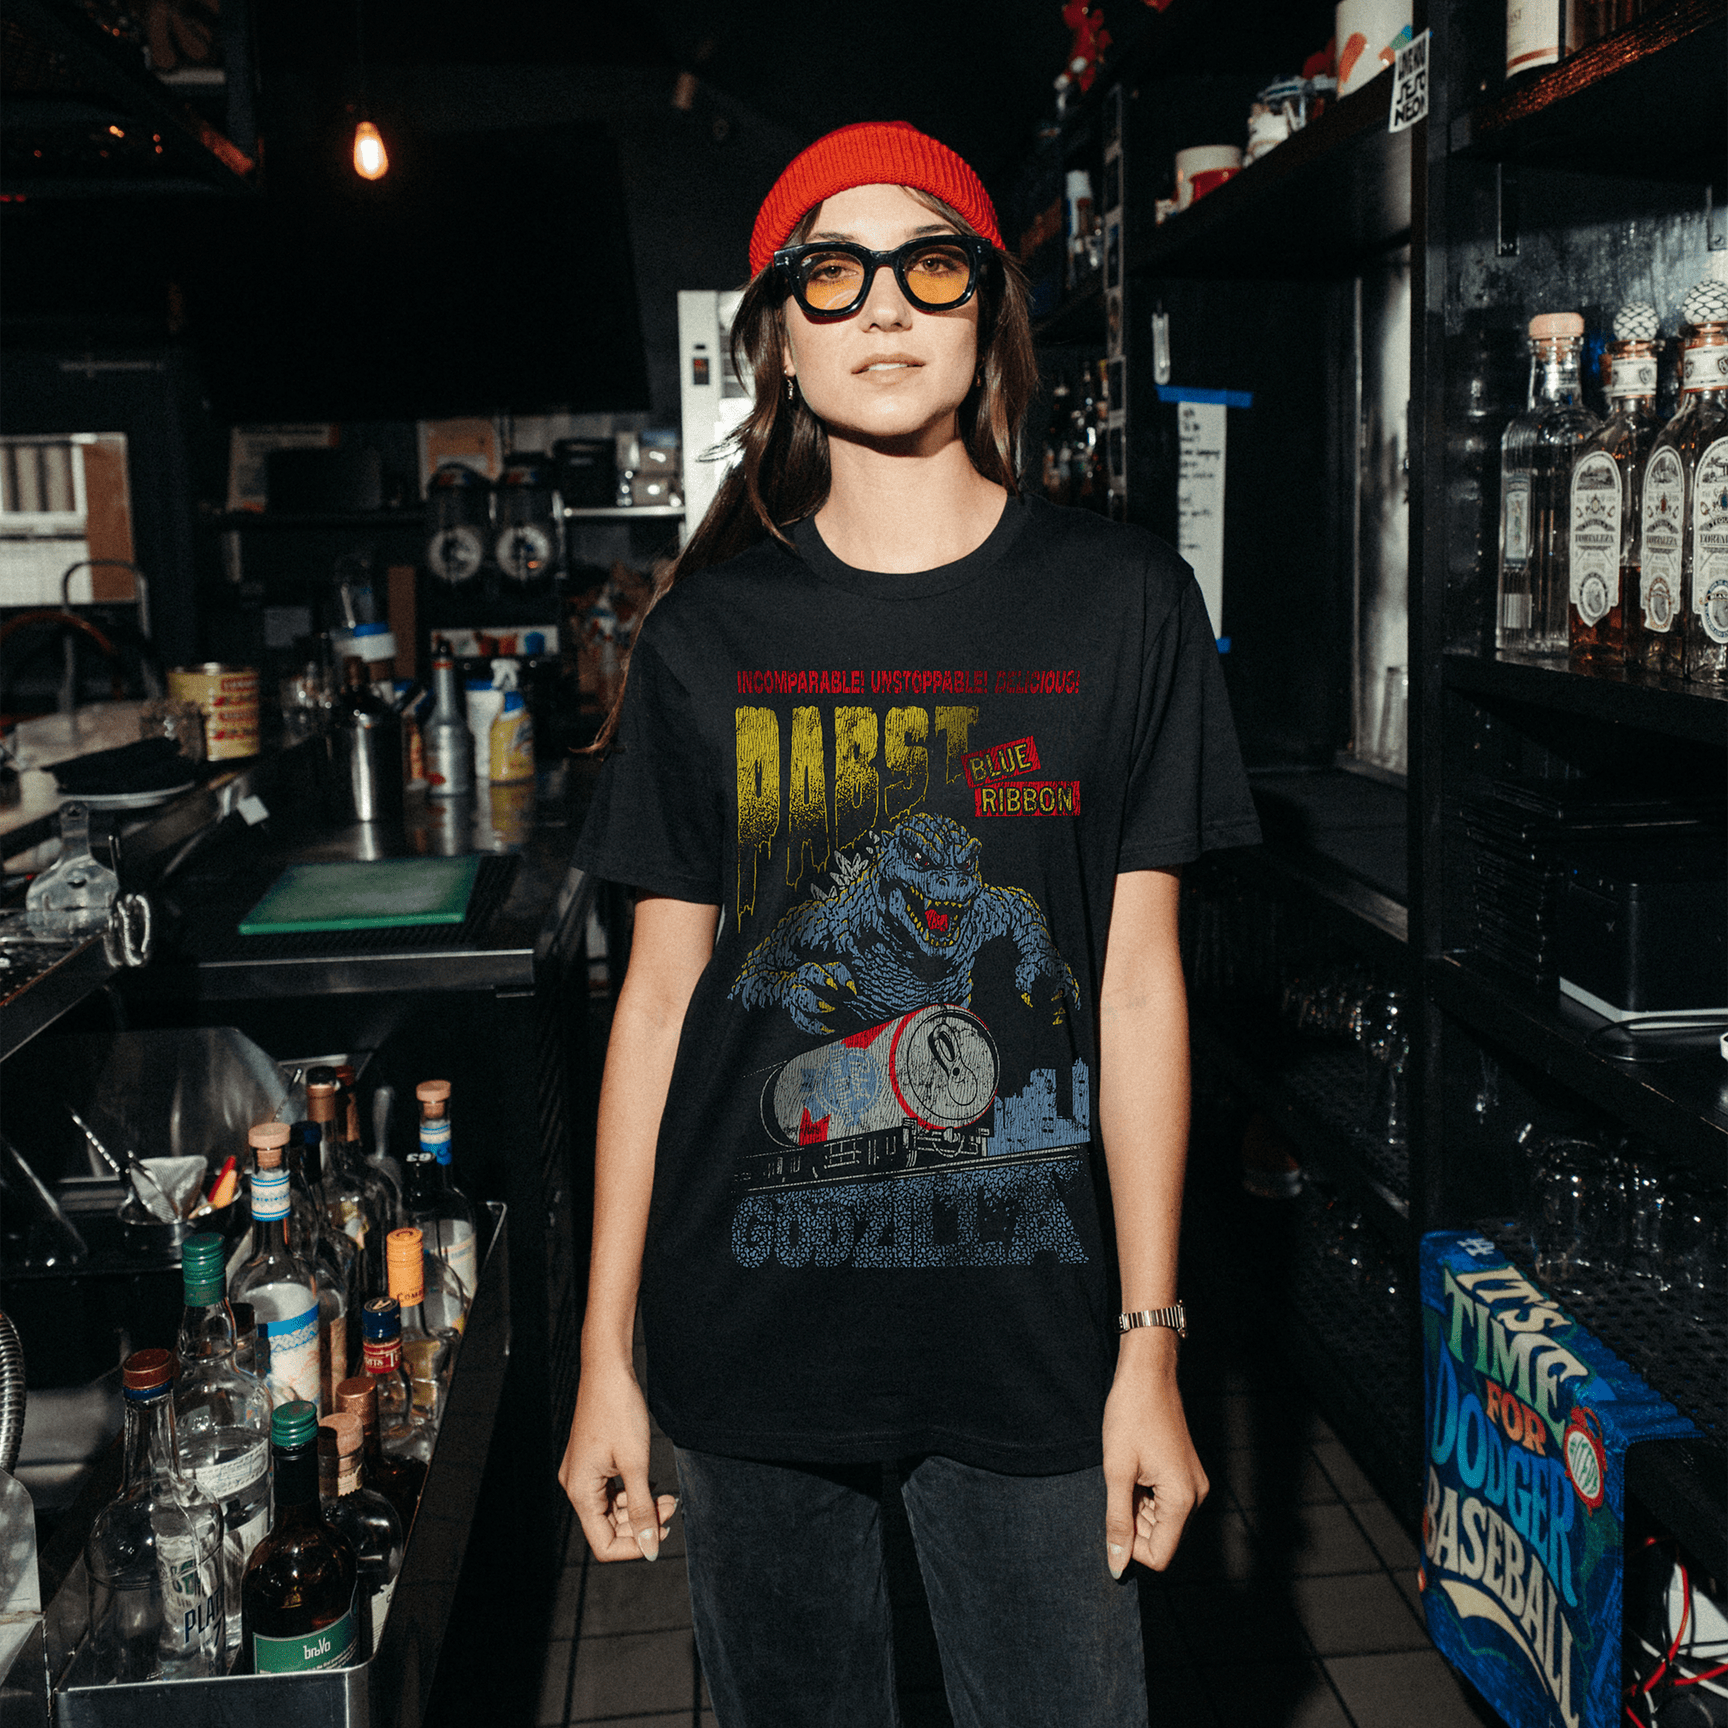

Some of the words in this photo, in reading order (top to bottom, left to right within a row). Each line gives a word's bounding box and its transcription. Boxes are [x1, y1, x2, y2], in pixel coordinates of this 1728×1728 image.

[736, 669, 865, 694] INCOMPARABLE!
[871, 669, 988, 694] UNSTOPPABLE!
[994, 669, 1081, 694] DELICIOUS!
[734, 705, 980, 895] PABST
[968, 742, 1033, 783] BLUE
[980, 786, 1075, 815] RIBBON
[731, 1160, 1090, 1268] GODZILLA
[1456, 1264, 1573, 1338] IT'S
[1443, 1267, 1589, 1448] TIME
[1485, 1379, 1548, 1457] FOR
[1430, 1330, 1579, 1608] DODGER
[1423, 1465, 1580, 1728] BASEBALL
